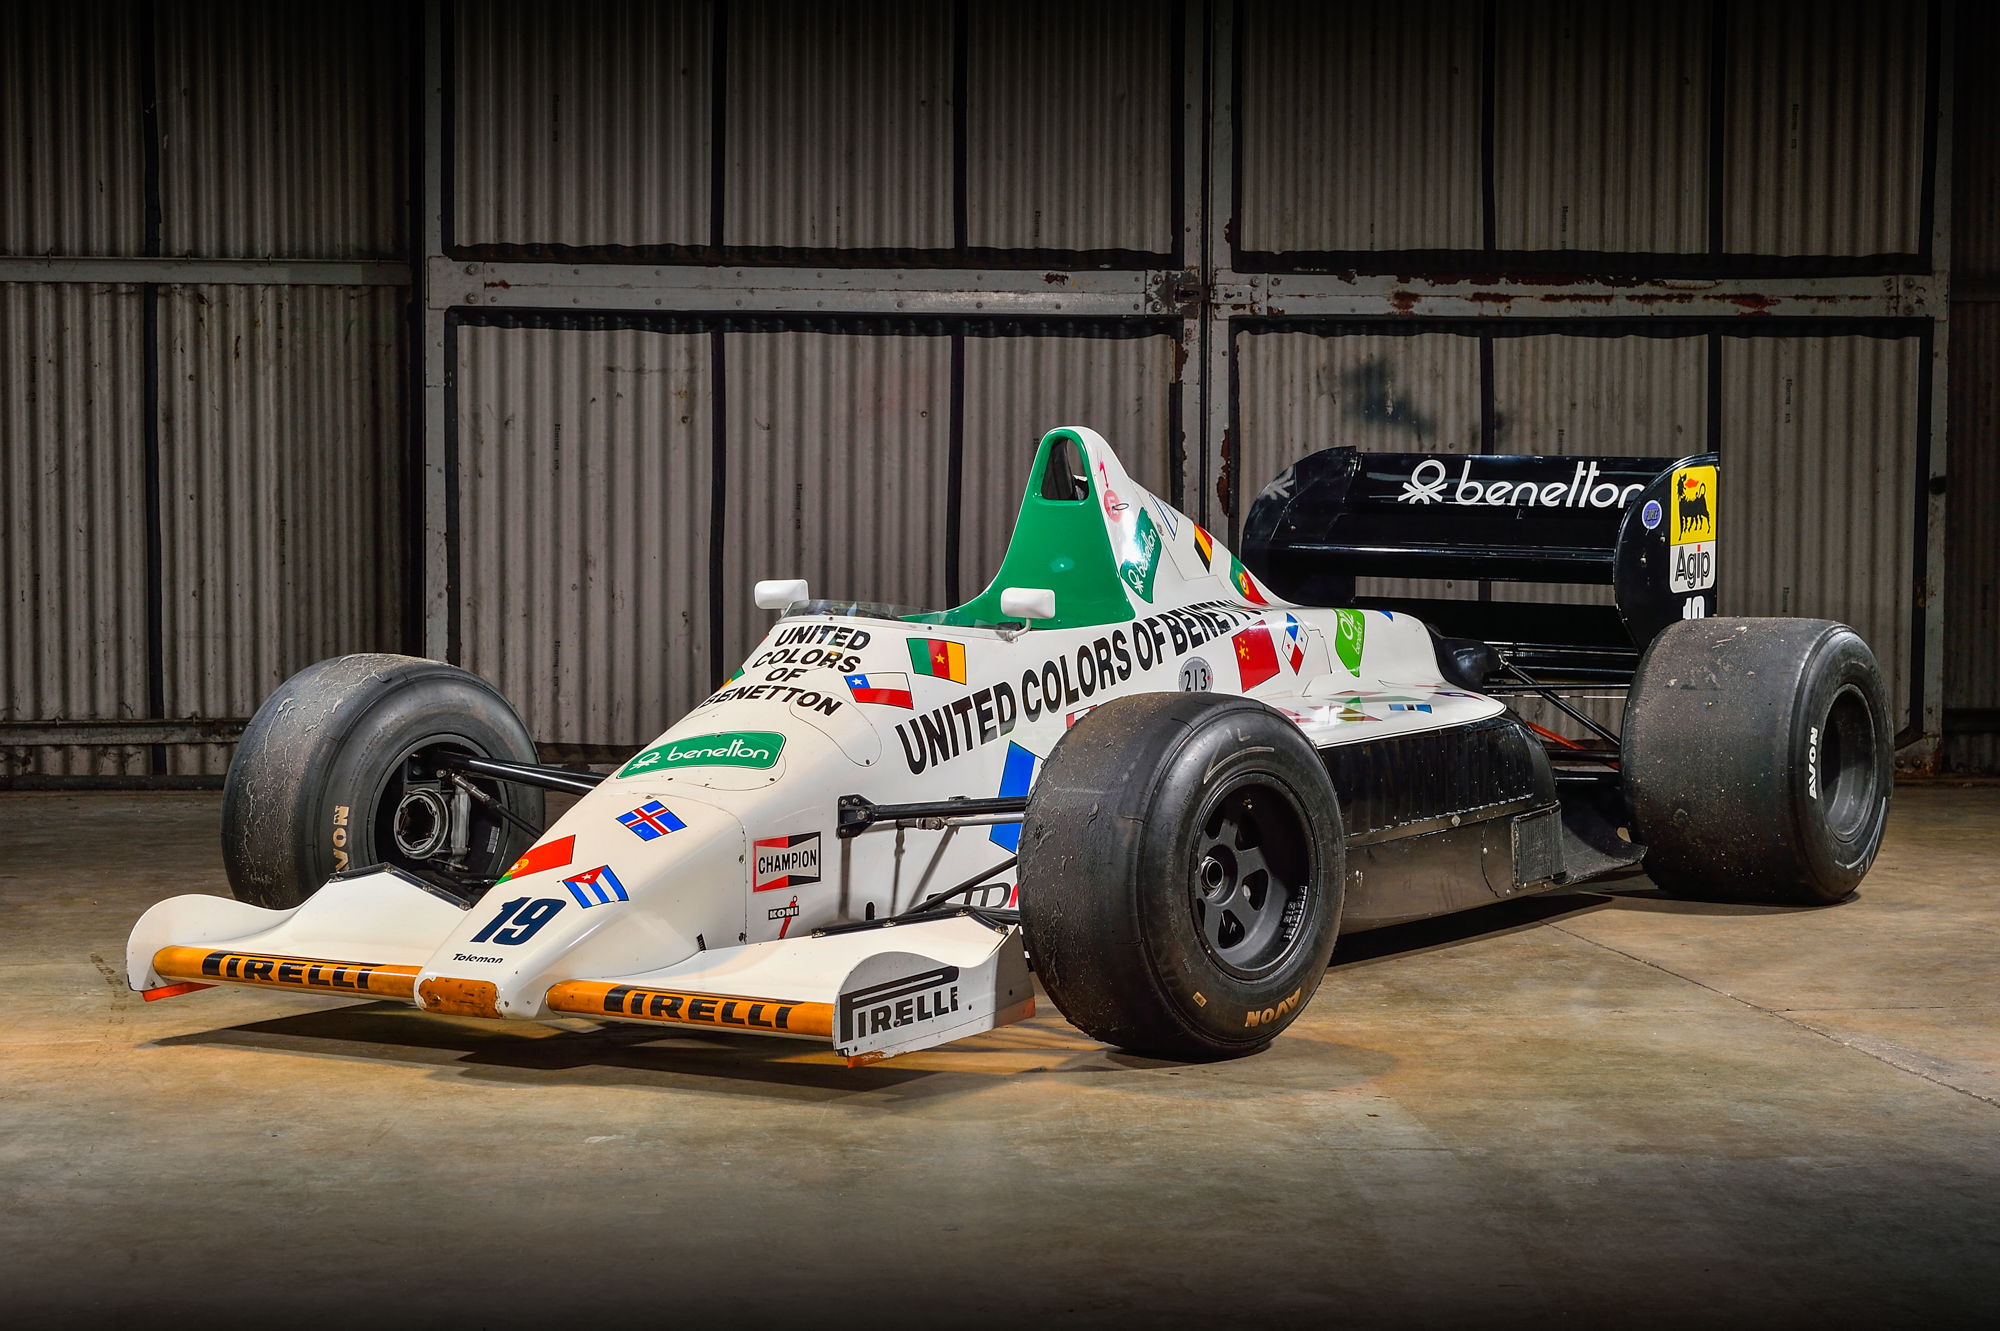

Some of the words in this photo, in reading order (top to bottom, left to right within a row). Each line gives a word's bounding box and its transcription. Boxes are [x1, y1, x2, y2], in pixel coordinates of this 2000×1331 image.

[1455, 459, 1646, 509] benetton
[1675, 544, 1711, 589] Agip
[774, 625, 871, 651] UNITED
[751, 648, 862, 673] COLORS
[765, 667, 809, 682] OF
[697, 685, 843, 717] BENETTON
[895, 681, 1017, 775] UNITED
[1021, 629, 1133, 722] COLORS
[1132, 617, 1166, 671] OF
[666, 738, 769, 761] benetton
[1808, 726, 1819, 800] AVON
[333, 805, 350, 873] VON
[758, 849, 817, 874] CHAMPION
[470, 896, 567, 945] 19
[769, 907, 799, 919] KONI
[202, 949, 387, 989] PIRELLI
[452, 952, 504, 966] Toleman
[603, 984, 805, 1030] PIRELLI
[839, 965, 959, 1043] PIRELLI
[1244, 987, 1302, 1028] AVON
